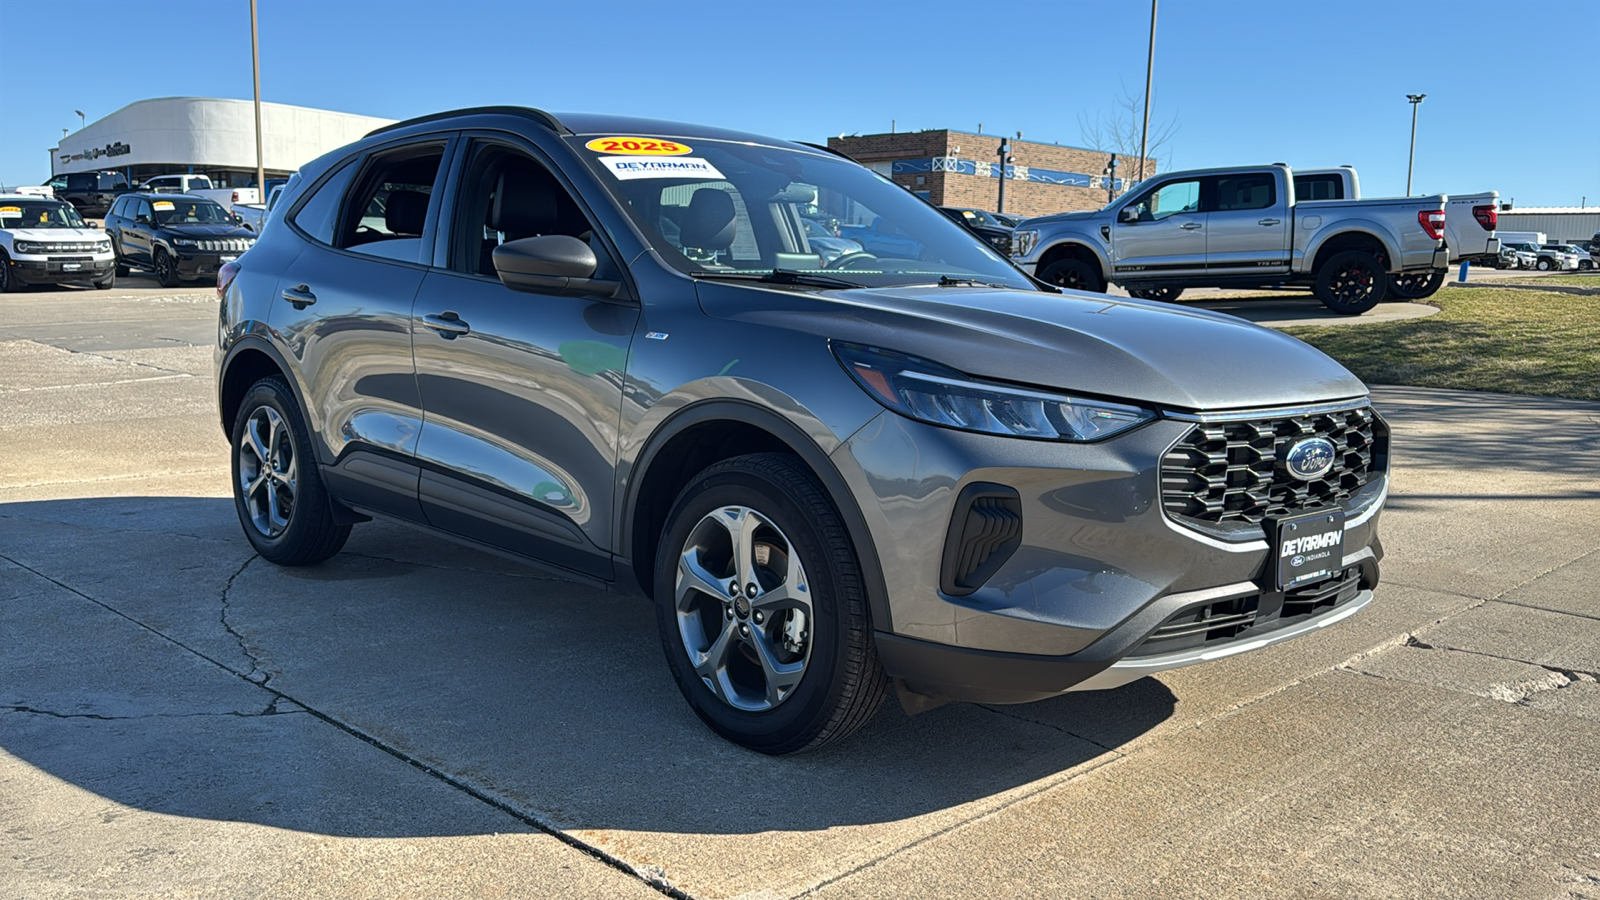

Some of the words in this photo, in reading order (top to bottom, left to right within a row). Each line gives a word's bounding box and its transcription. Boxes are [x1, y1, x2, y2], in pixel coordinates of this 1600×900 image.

[601, 141, 680, 151] 2025
[615, 162, 708, 170] DEYARMAN
[1281, 530, 1342, 557] DEYARMAN
[1306, 551, 1330, 561] INDIANOLA
